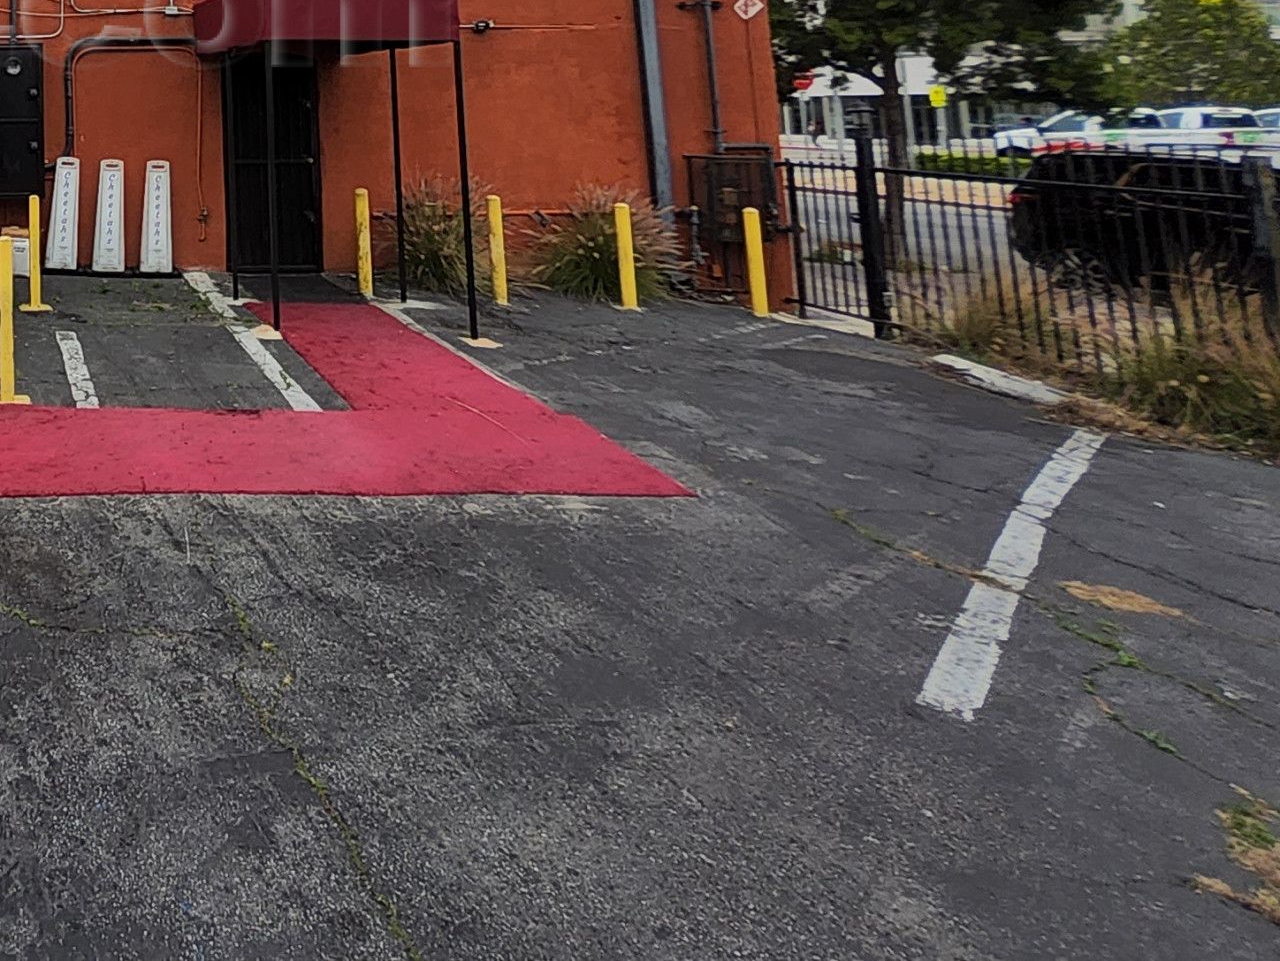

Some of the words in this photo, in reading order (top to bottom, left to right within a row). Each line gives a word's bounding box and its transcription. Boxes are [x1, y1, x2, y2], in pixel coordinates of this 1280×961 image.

[59, 170, 72, 243] Cheetahs
[106, 173, 116, 245] Cheetahs
[153, 174, 162, 246] Cheetahs
